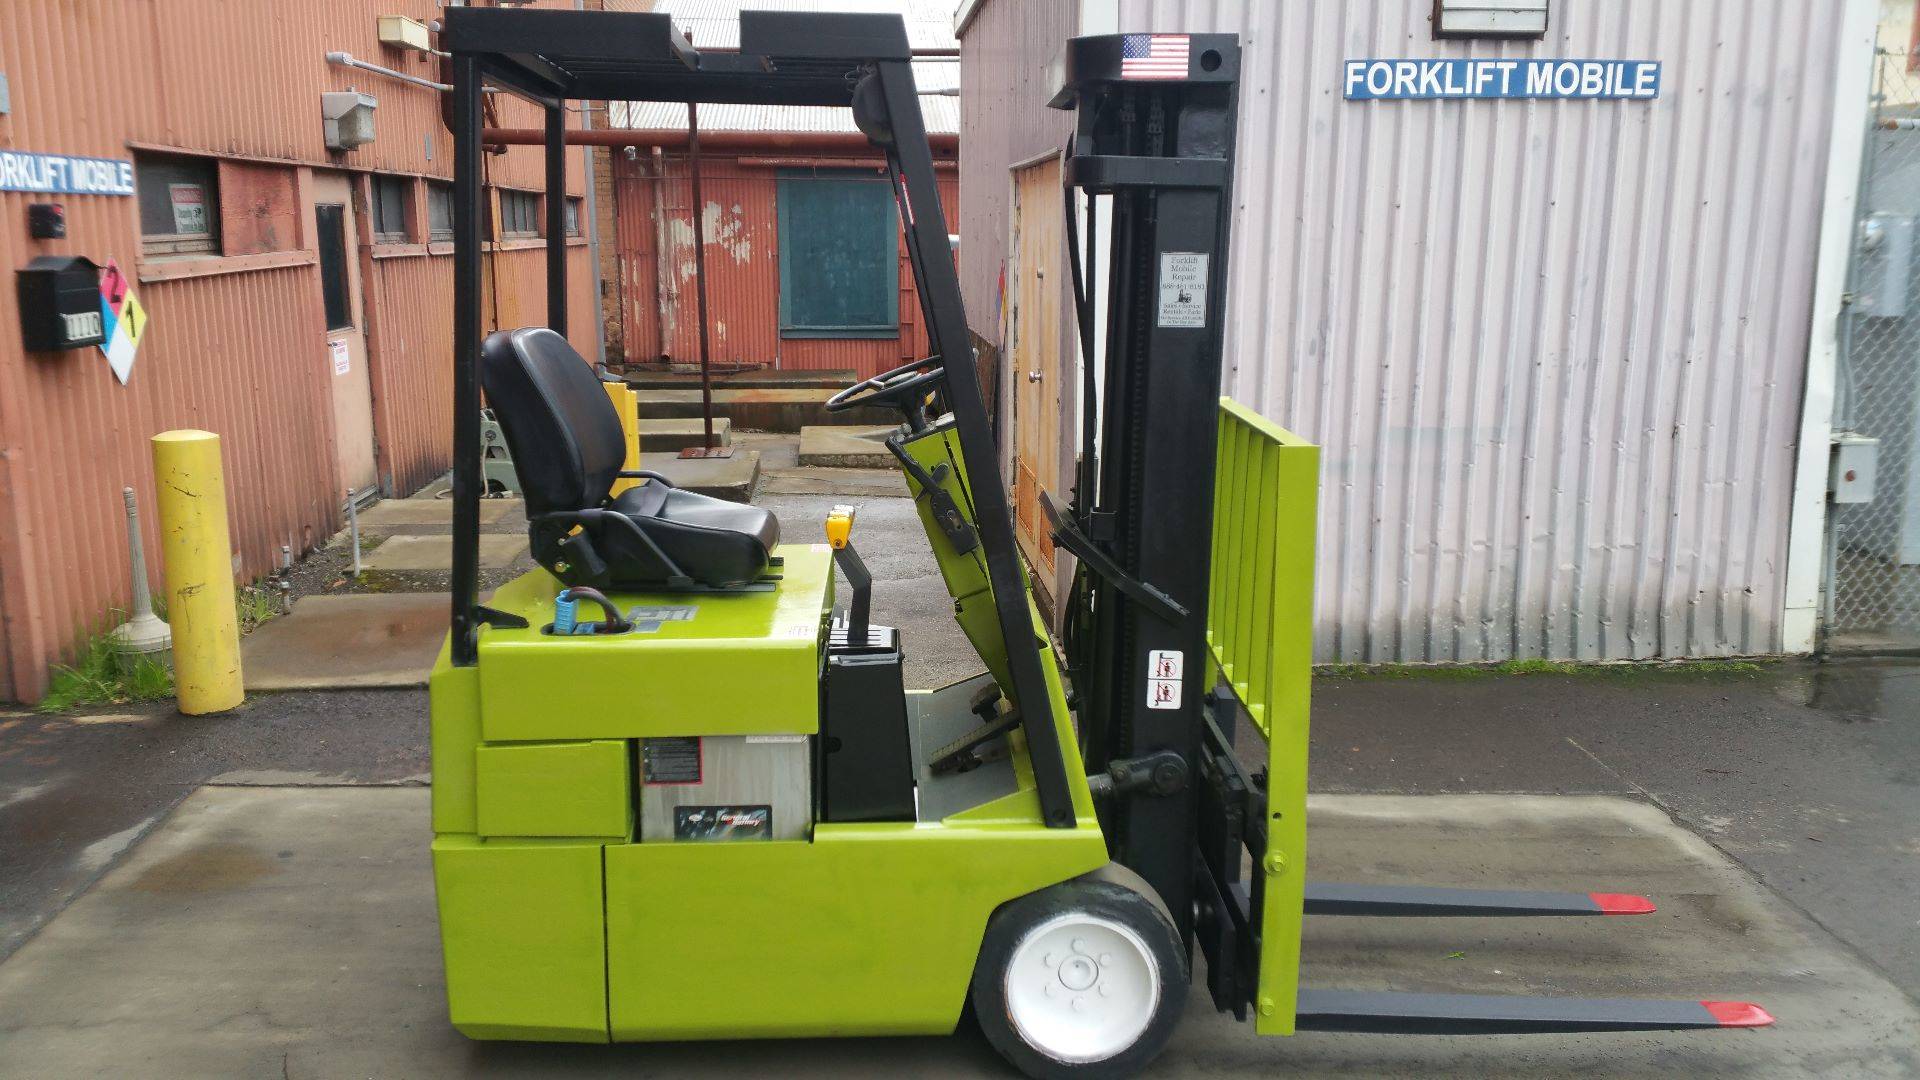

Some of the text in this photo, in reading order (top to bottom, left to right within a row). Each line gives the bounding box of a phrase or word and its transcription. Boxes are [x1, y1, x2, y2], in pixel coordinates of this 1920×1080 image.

[1346, 61, 1658, 96] FORKLIFT MOBILE
[71, 158, 134, 193] MOBILE
[107, 265, 122, 304] 2
[1172, 273, 1196, 281] Repair
